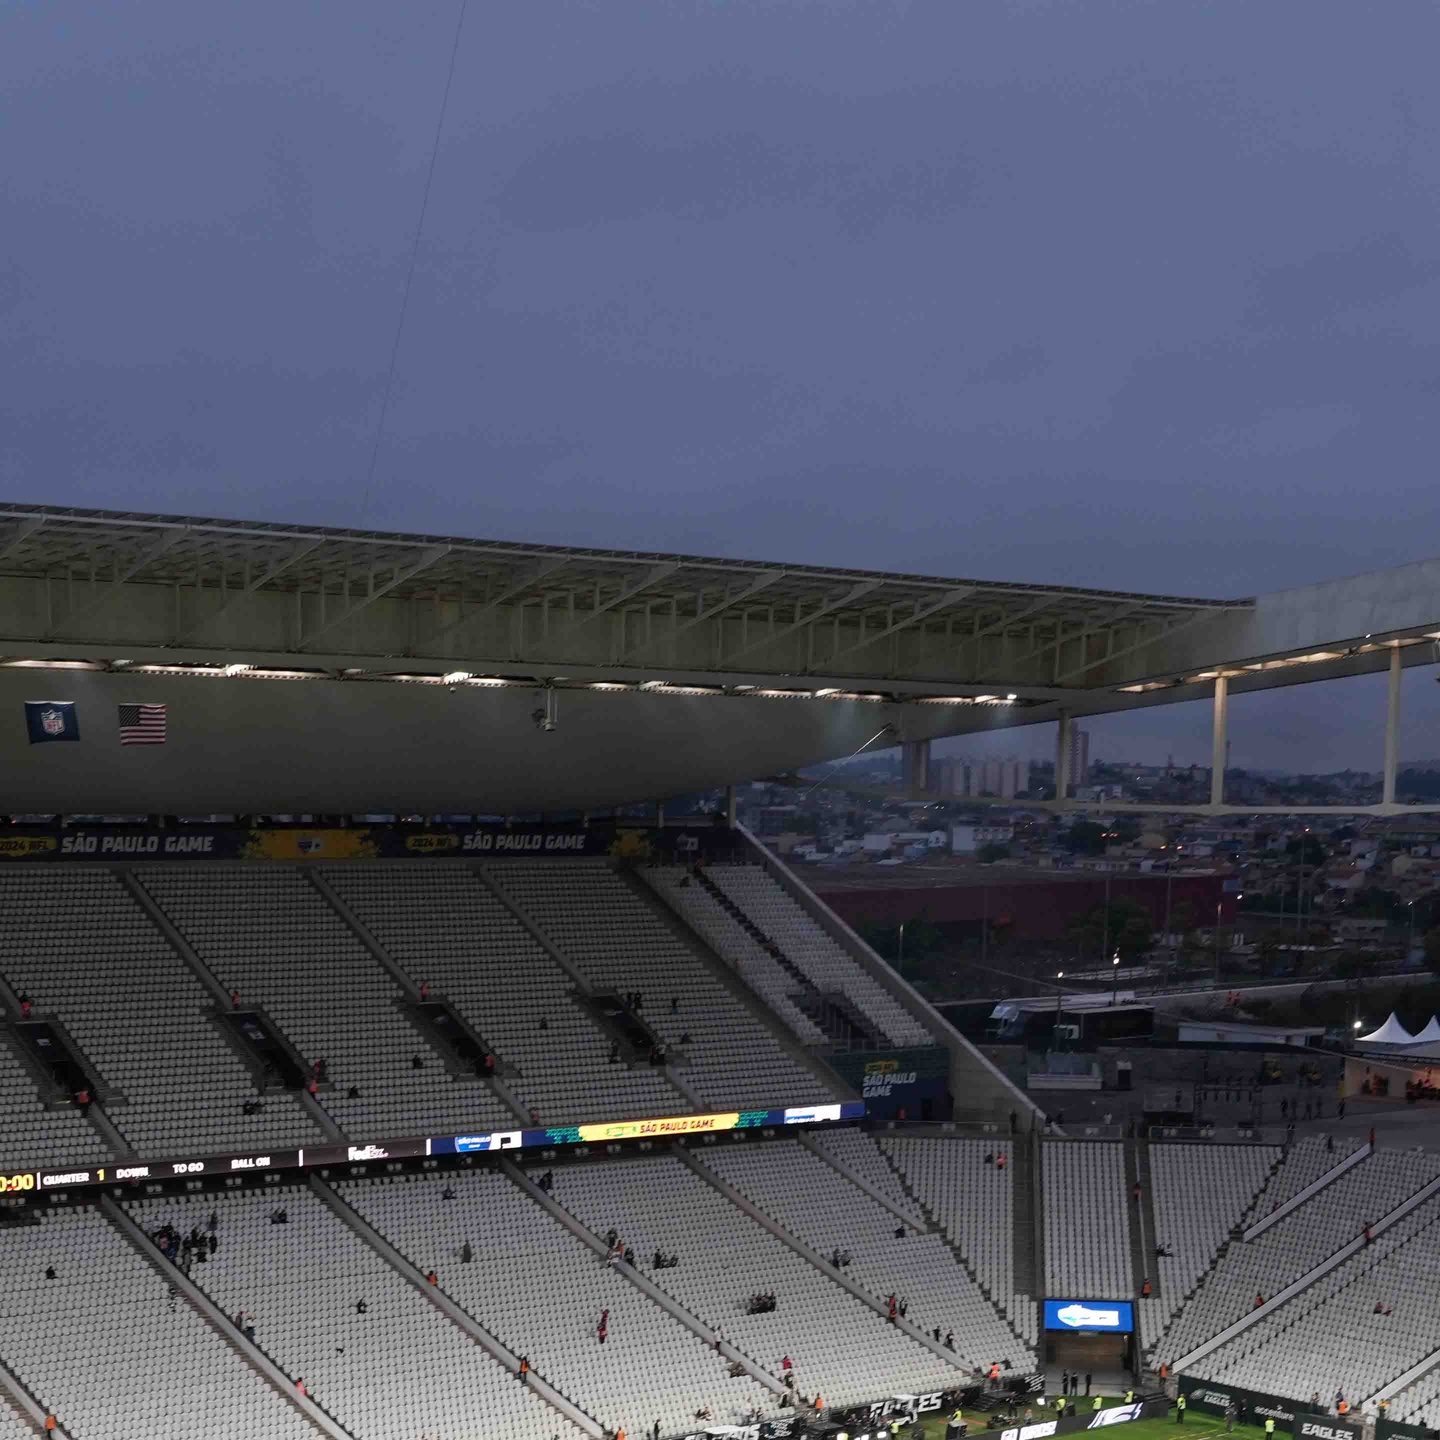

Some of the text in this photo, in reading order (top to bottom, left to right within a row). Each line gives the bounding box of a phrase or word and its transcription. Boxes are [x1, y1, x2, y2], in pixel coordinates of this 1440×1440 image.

[0, 840, 26, 850] 2024
[61, 832, 214, 853] SÃO PAULO GAME
[412, 837, 435, 848] 2024
[463, 830, 586, 849] SÃO PAULO GAME
[862, 1071, 917, 1087] SÃO PAULO
[862, 1085, 892, 1098] GAME
[639, 1121, 658, 1134] SÃO
[660, 1120, 689, 1133] PAULO
[690, 1118, 714, 1130] GAME
[172, 1161, 204, 1174] TO GO
[231, 1156, 270, 1169] BALL ON
[43, 1169, 105, 1187] QUARTER 1
[116, 1166, 148, 1180] DOWN
[1254, 1405, 1295, 1422] accenture
